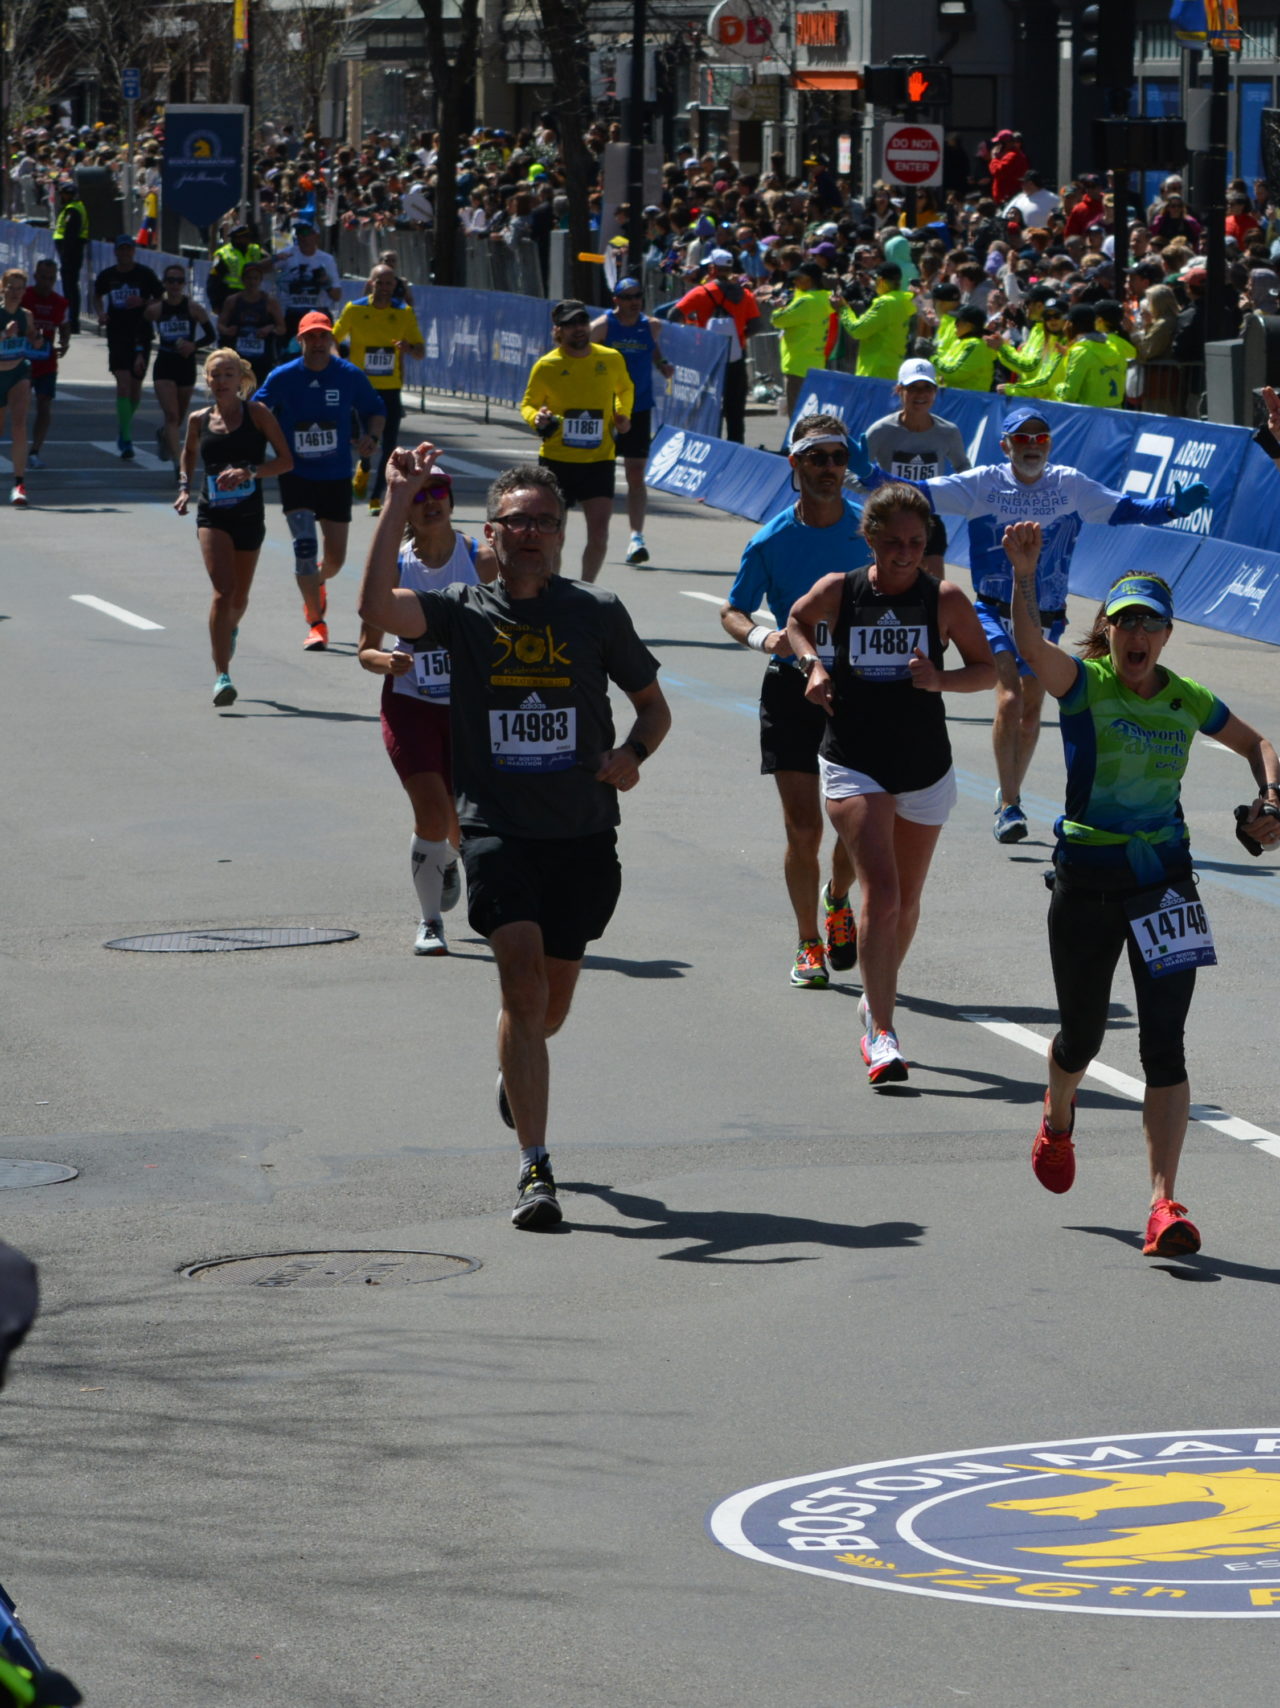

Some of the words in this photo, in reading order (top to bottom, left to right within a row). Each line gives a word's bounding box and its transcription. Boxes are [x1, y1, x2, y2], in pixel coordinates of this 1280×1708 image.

[891, 138, 910, 150] DO
[912, 138, 933, 150] NOT
[895, 161, 931, 173] ENTER
[567, 420, 599, 435] 11861
[896, 465, 935, 481] 15165
[986, 493, 1069, 508] SINGAPORE
[1000, 505, 1028, 515] RUN
[1032, 507, 1056, 516] 2021
[858, 628, 921, 655] 14887
[498, 711, 568, 742] 14983
[778, 1461, 1021, 1551] BOSTON
